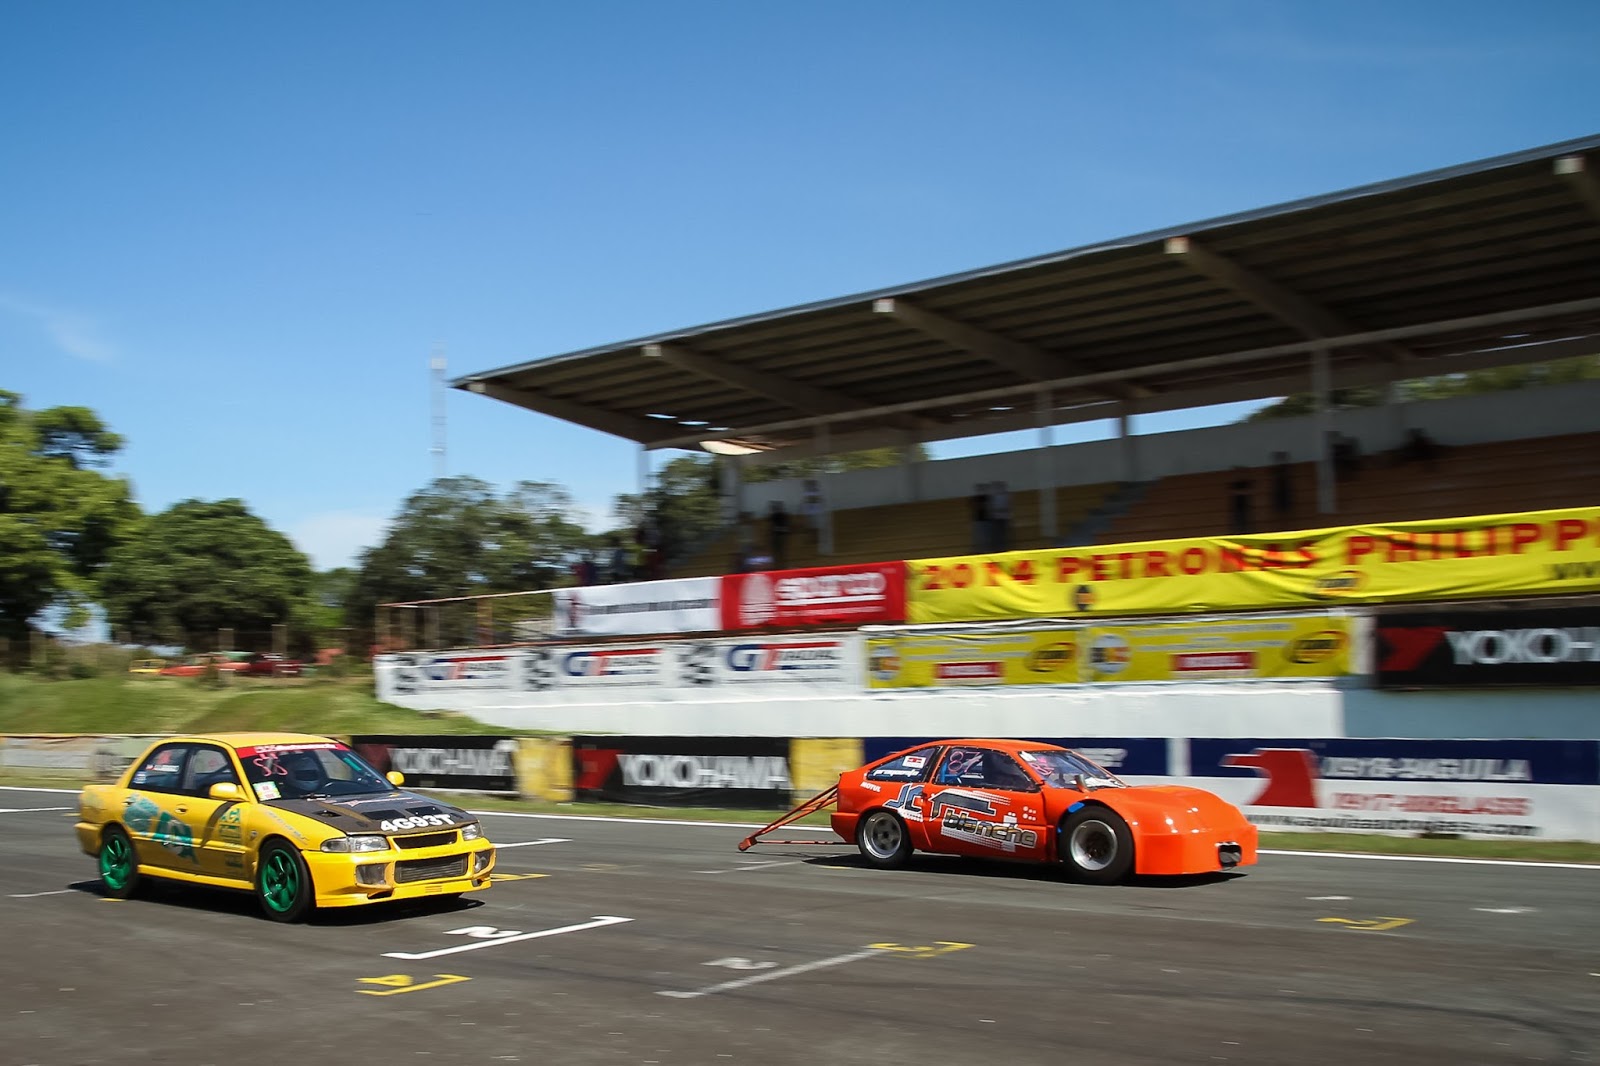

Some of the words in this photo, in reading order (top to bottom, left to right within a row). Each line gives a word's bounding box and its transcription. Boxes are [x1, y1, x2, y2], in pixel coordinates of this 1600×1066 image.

[921, 560, 1037, 590] 2014
[1056, 540, 1317, 583] PETRONAS
[1346, 517, 1600, 564] PHILIPP
[386, 748, 515, 777] YOKOHAMA
[616, 754, 794, 790] YOKOHAMA
[948, 751, 981, 773] 87
[860, 781, 882, 793] MOTUL
[380, 813, 455, 832] 4G93T
[943, 808, 1037, 848] blanche
